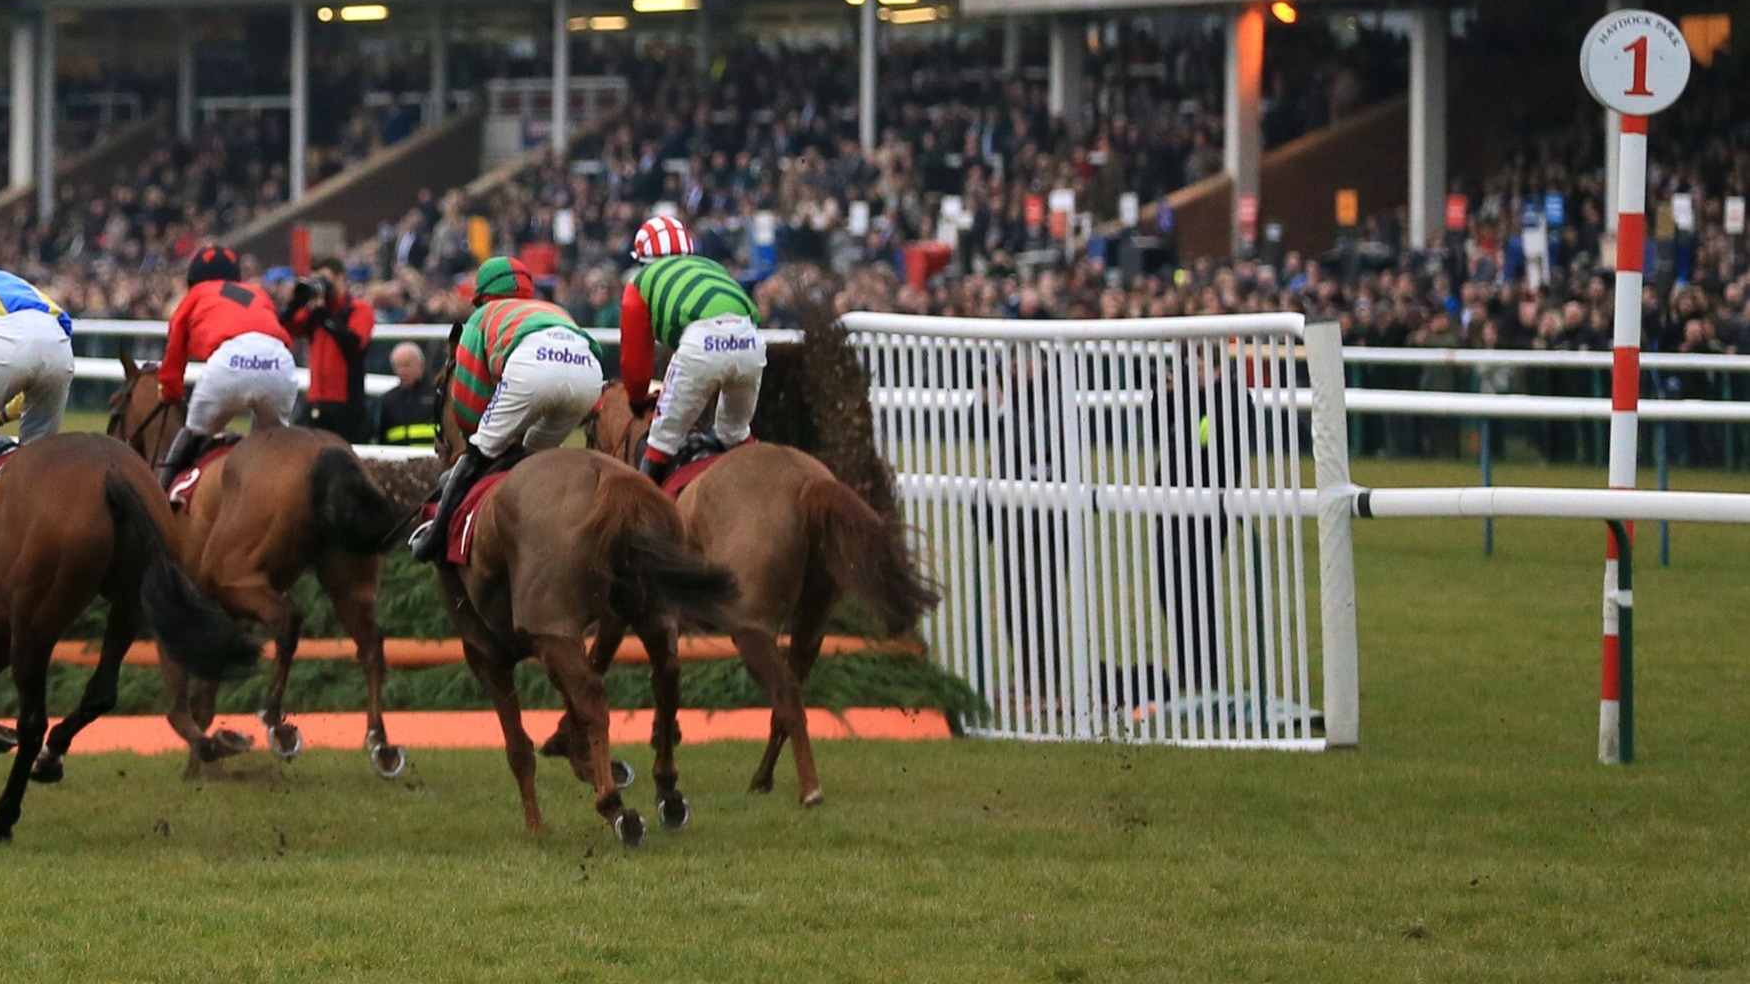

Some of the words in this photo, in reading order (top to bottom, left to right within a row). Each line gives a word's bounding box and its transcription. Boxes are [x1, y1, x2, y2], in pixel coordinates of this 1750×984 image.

[1598, 15, 1652, 45] HAYDOCK
[1655, 20, 1681, 47] PARK
[1623, 35, 1654, 96] 1
[704, 334, 756, 351] Stobart
[230, 354, 280, 370] Stobart
